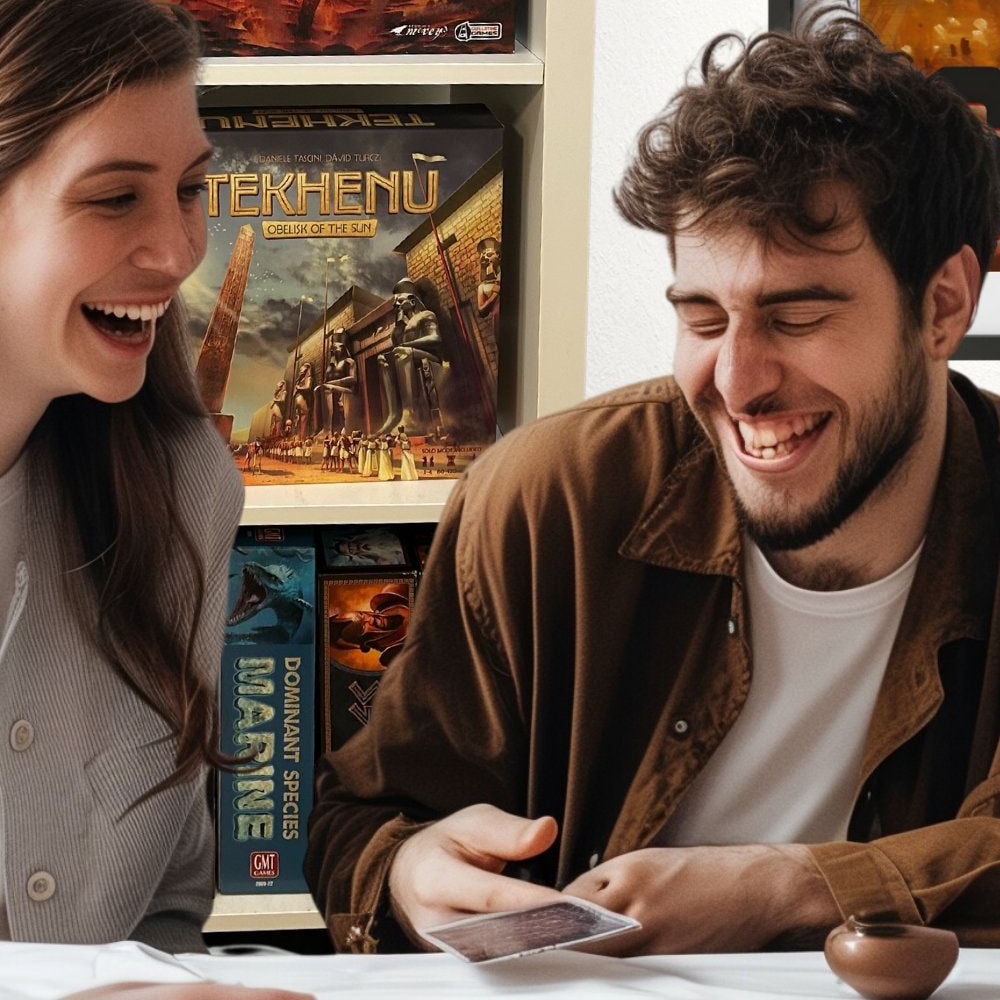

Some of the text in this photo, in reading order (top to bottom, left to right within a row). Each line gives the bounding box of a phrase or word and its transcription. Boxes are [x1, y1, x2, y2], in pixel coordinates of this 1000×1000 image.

[204, 170, 439, 216] TEKHENU
[267, 223, 371, 235] OBELISK OF THE SUN
[282, 657, 300, 763] DOMINANT
[235, 657, 275, 840] MARINE
[282, 770, 299, 840] SPECIES
[254, 854, 275, 870] GMT
